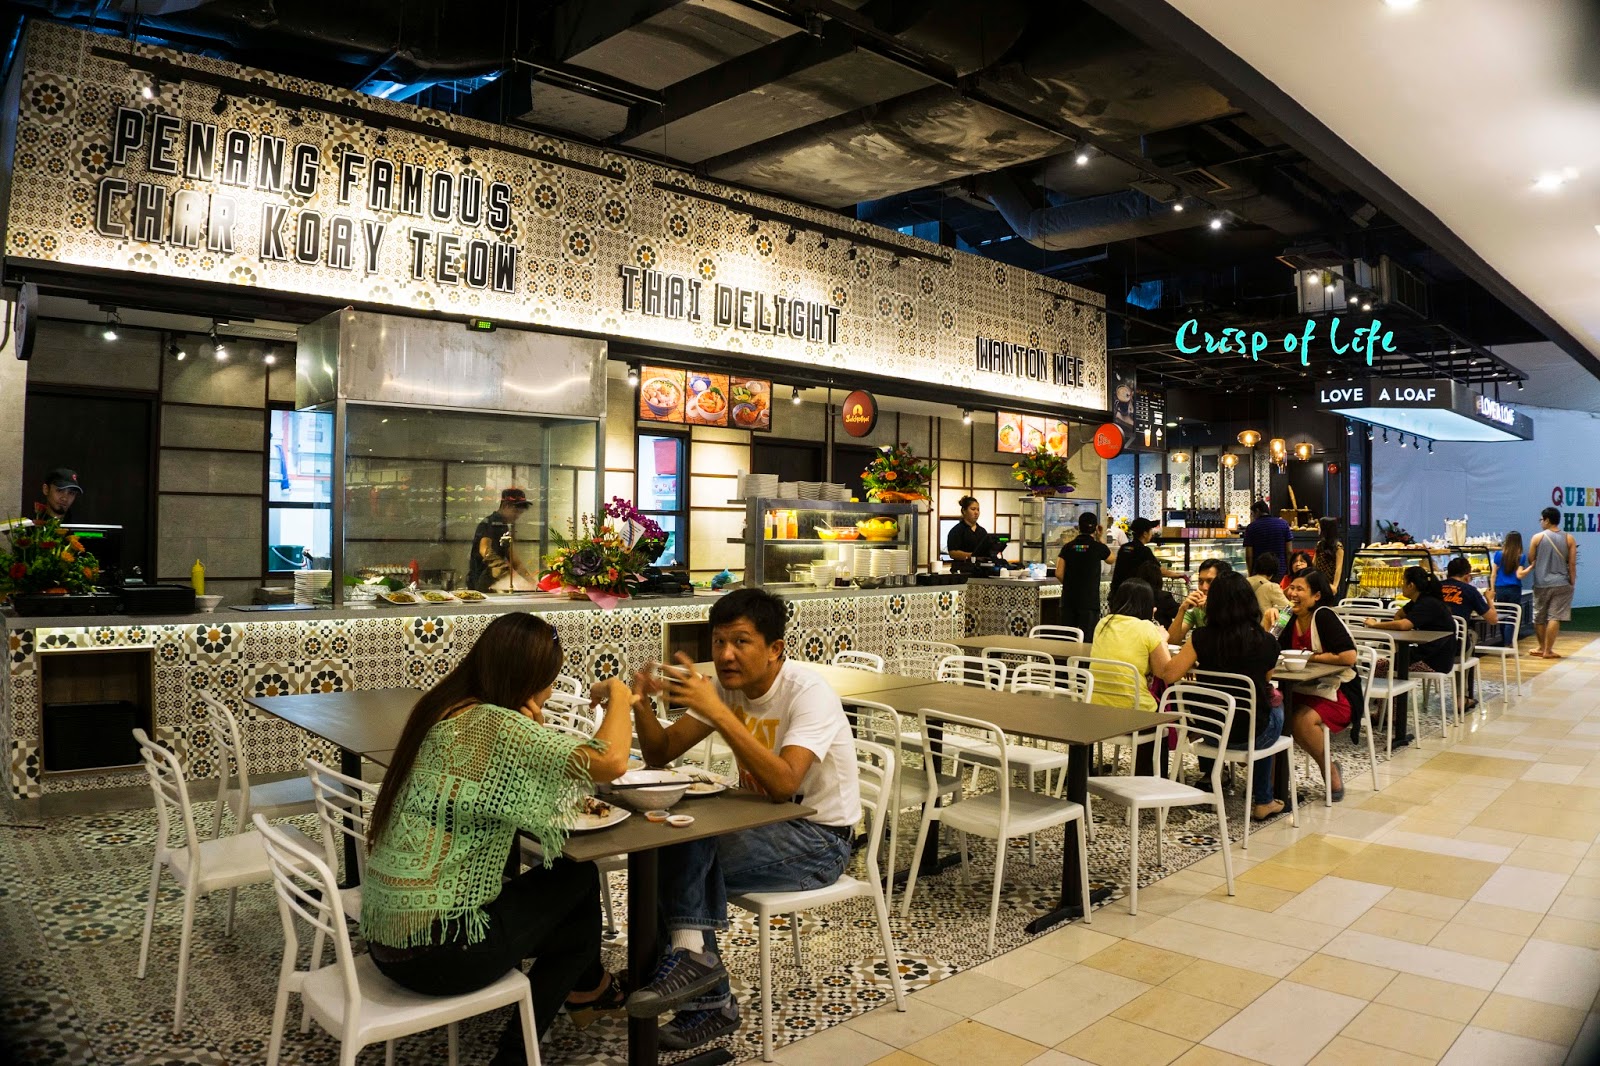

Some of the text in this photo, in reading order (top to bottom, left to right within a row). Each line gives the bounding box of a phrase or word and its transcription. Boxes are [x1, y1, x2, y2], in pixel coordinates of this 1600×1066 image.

[113, 106, 511, 232] PENANG FAMOUS
[97, 177, 517, 294] CHAR KOAY TEOW
[620, 265, 841, 345] THAI DELIGHT
[976, 336, 1084, 388] WANTON MEE
[1175, 317, 1397, 366] Crisp of Life
[1321, 388, 1436, 403] LOVE A LOAF
